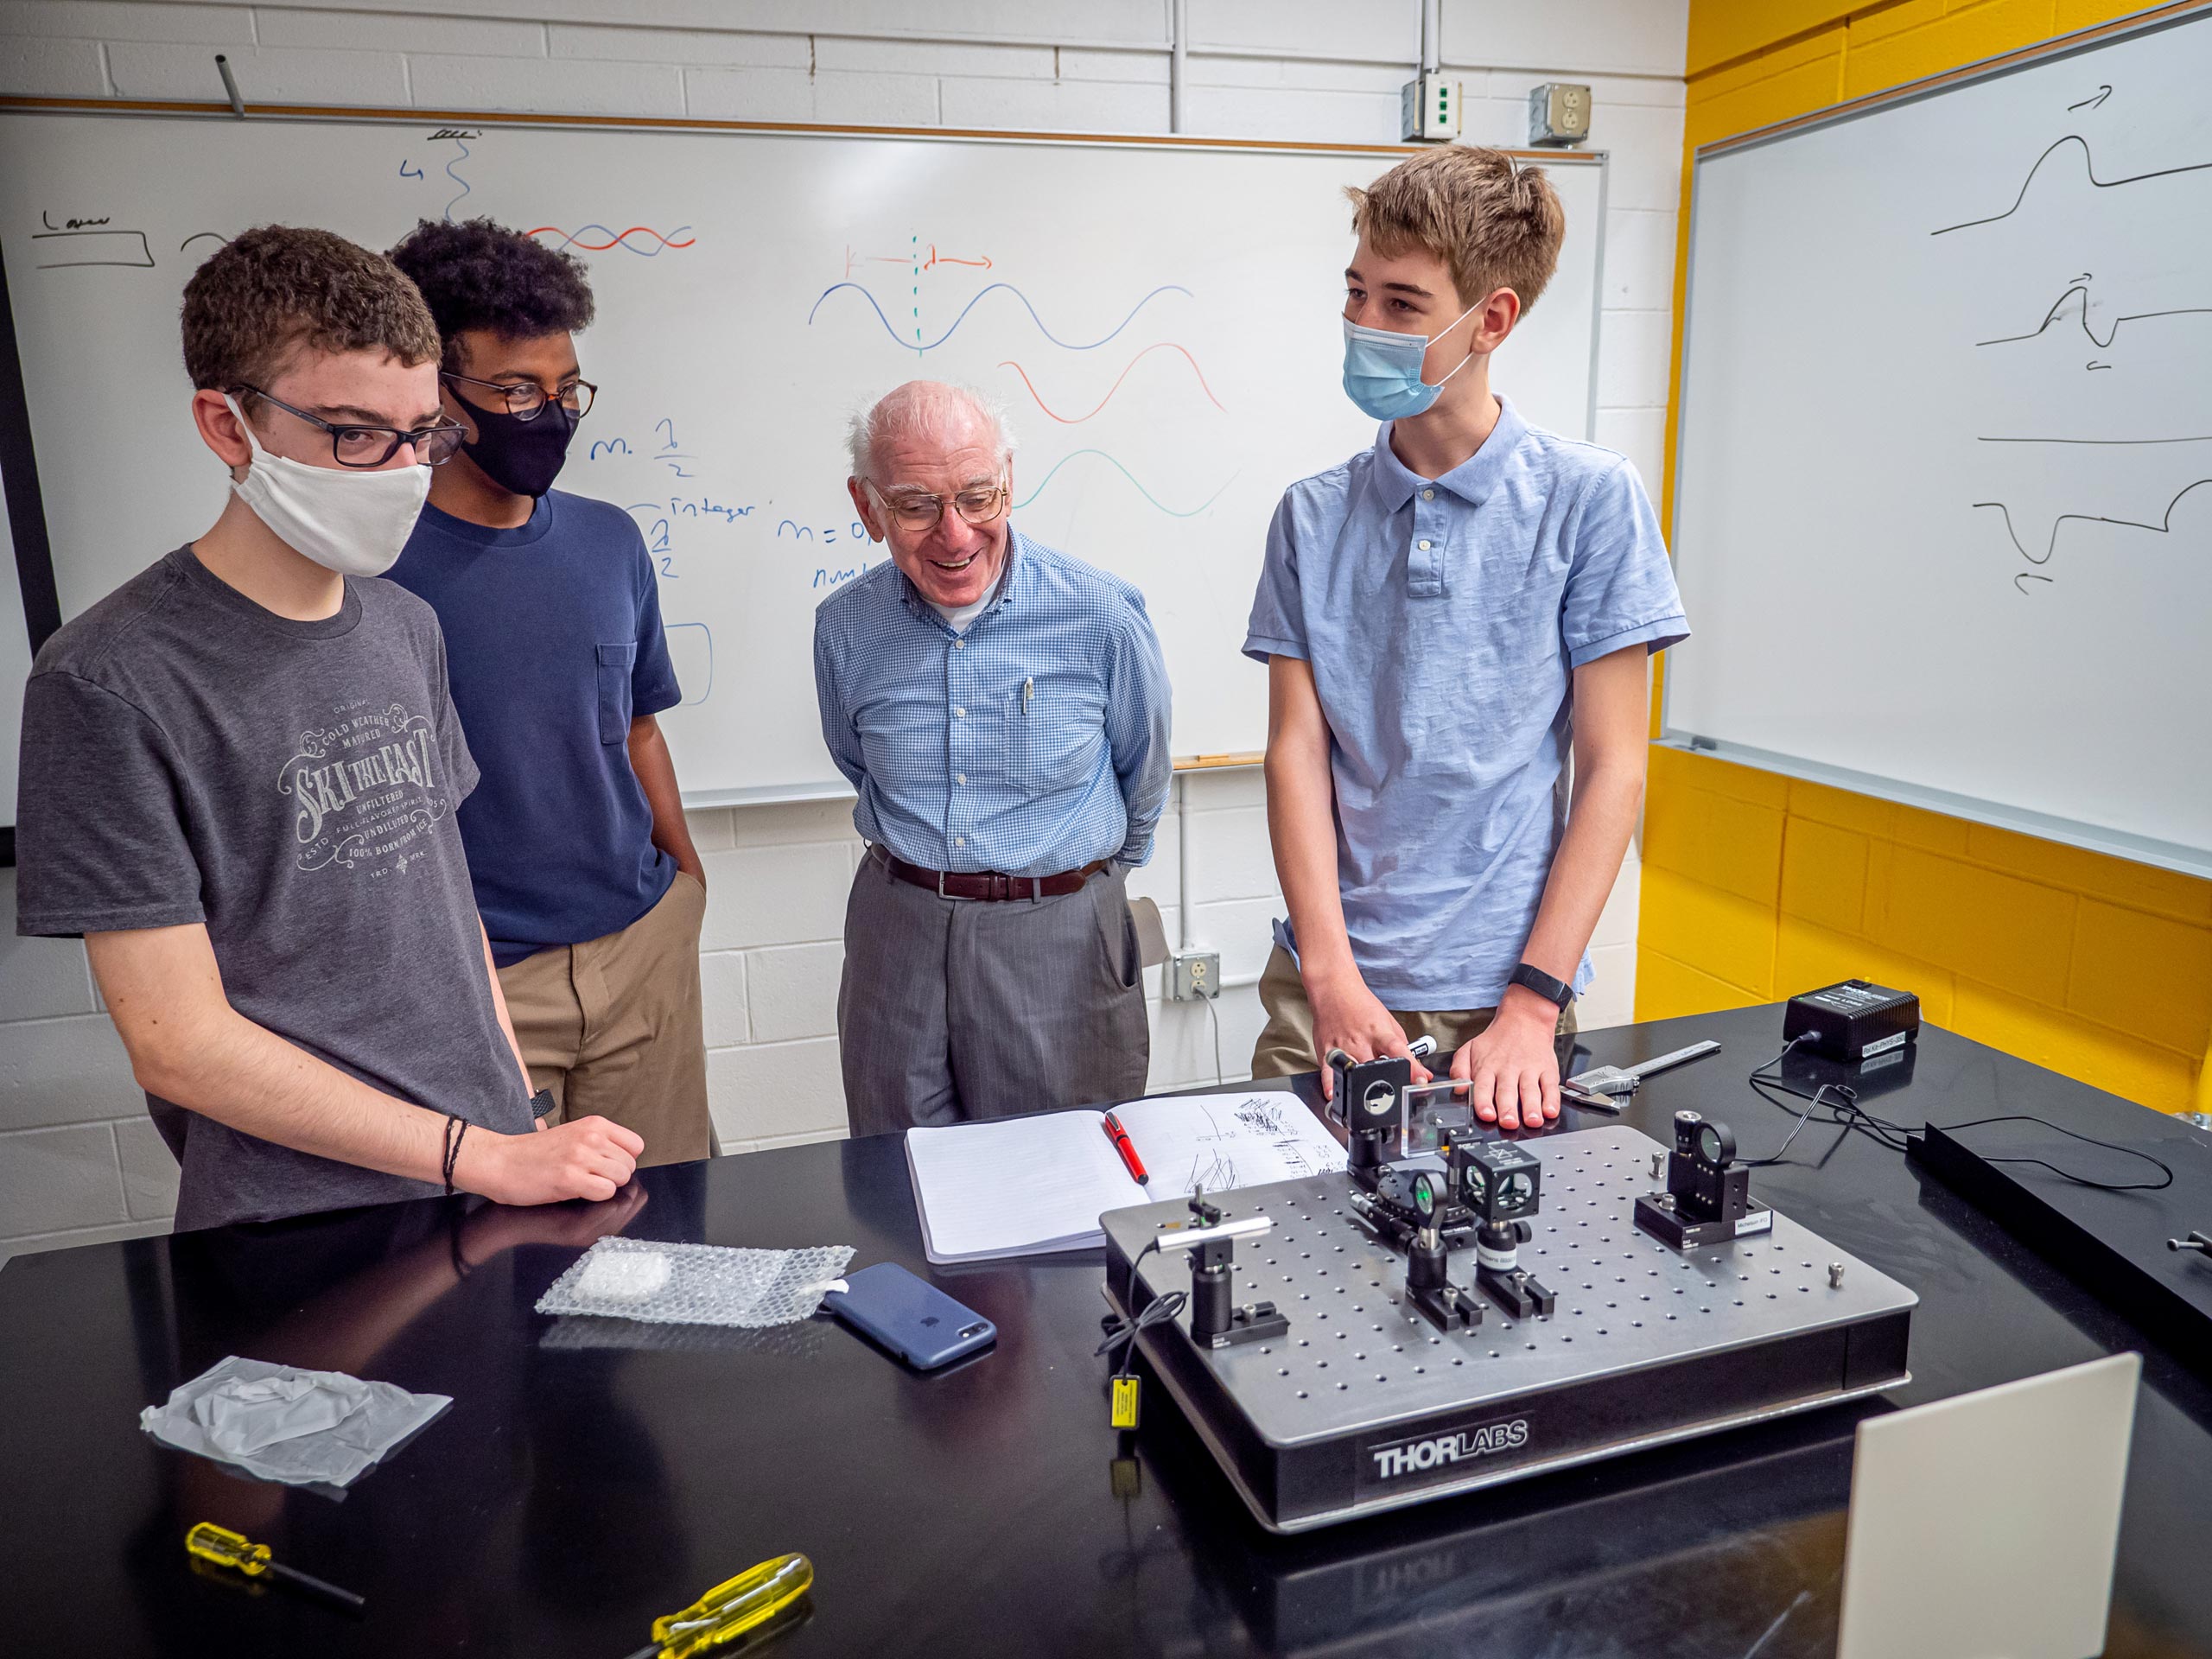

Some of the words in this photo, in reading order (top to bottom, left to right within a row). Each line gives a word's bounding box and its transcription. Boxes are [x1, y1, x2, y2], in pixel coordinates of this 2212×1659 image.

[671, 498, 756, 523] integer
[322, 723, 349, 746] COLD
[352, 715, 390, 728] WEATHER
[342, 728, 381, 748] MATURED
[296, 760, 358, 844] SKI
[348, 754, 387, 791] THE
[378, 728, 435, 788] EAST
[356, 790, 404, 815] UNFILTERED
[349, 848, 372, 857] 100%
[375, 837, 400, 855] BORN
[400, 830, 416, 847] FROM
[416, 818, 429, 833] ICE
[364, 814, 409, 840] UNDILUTED
[1374, 1419, 1528, 1478] THORLABS
